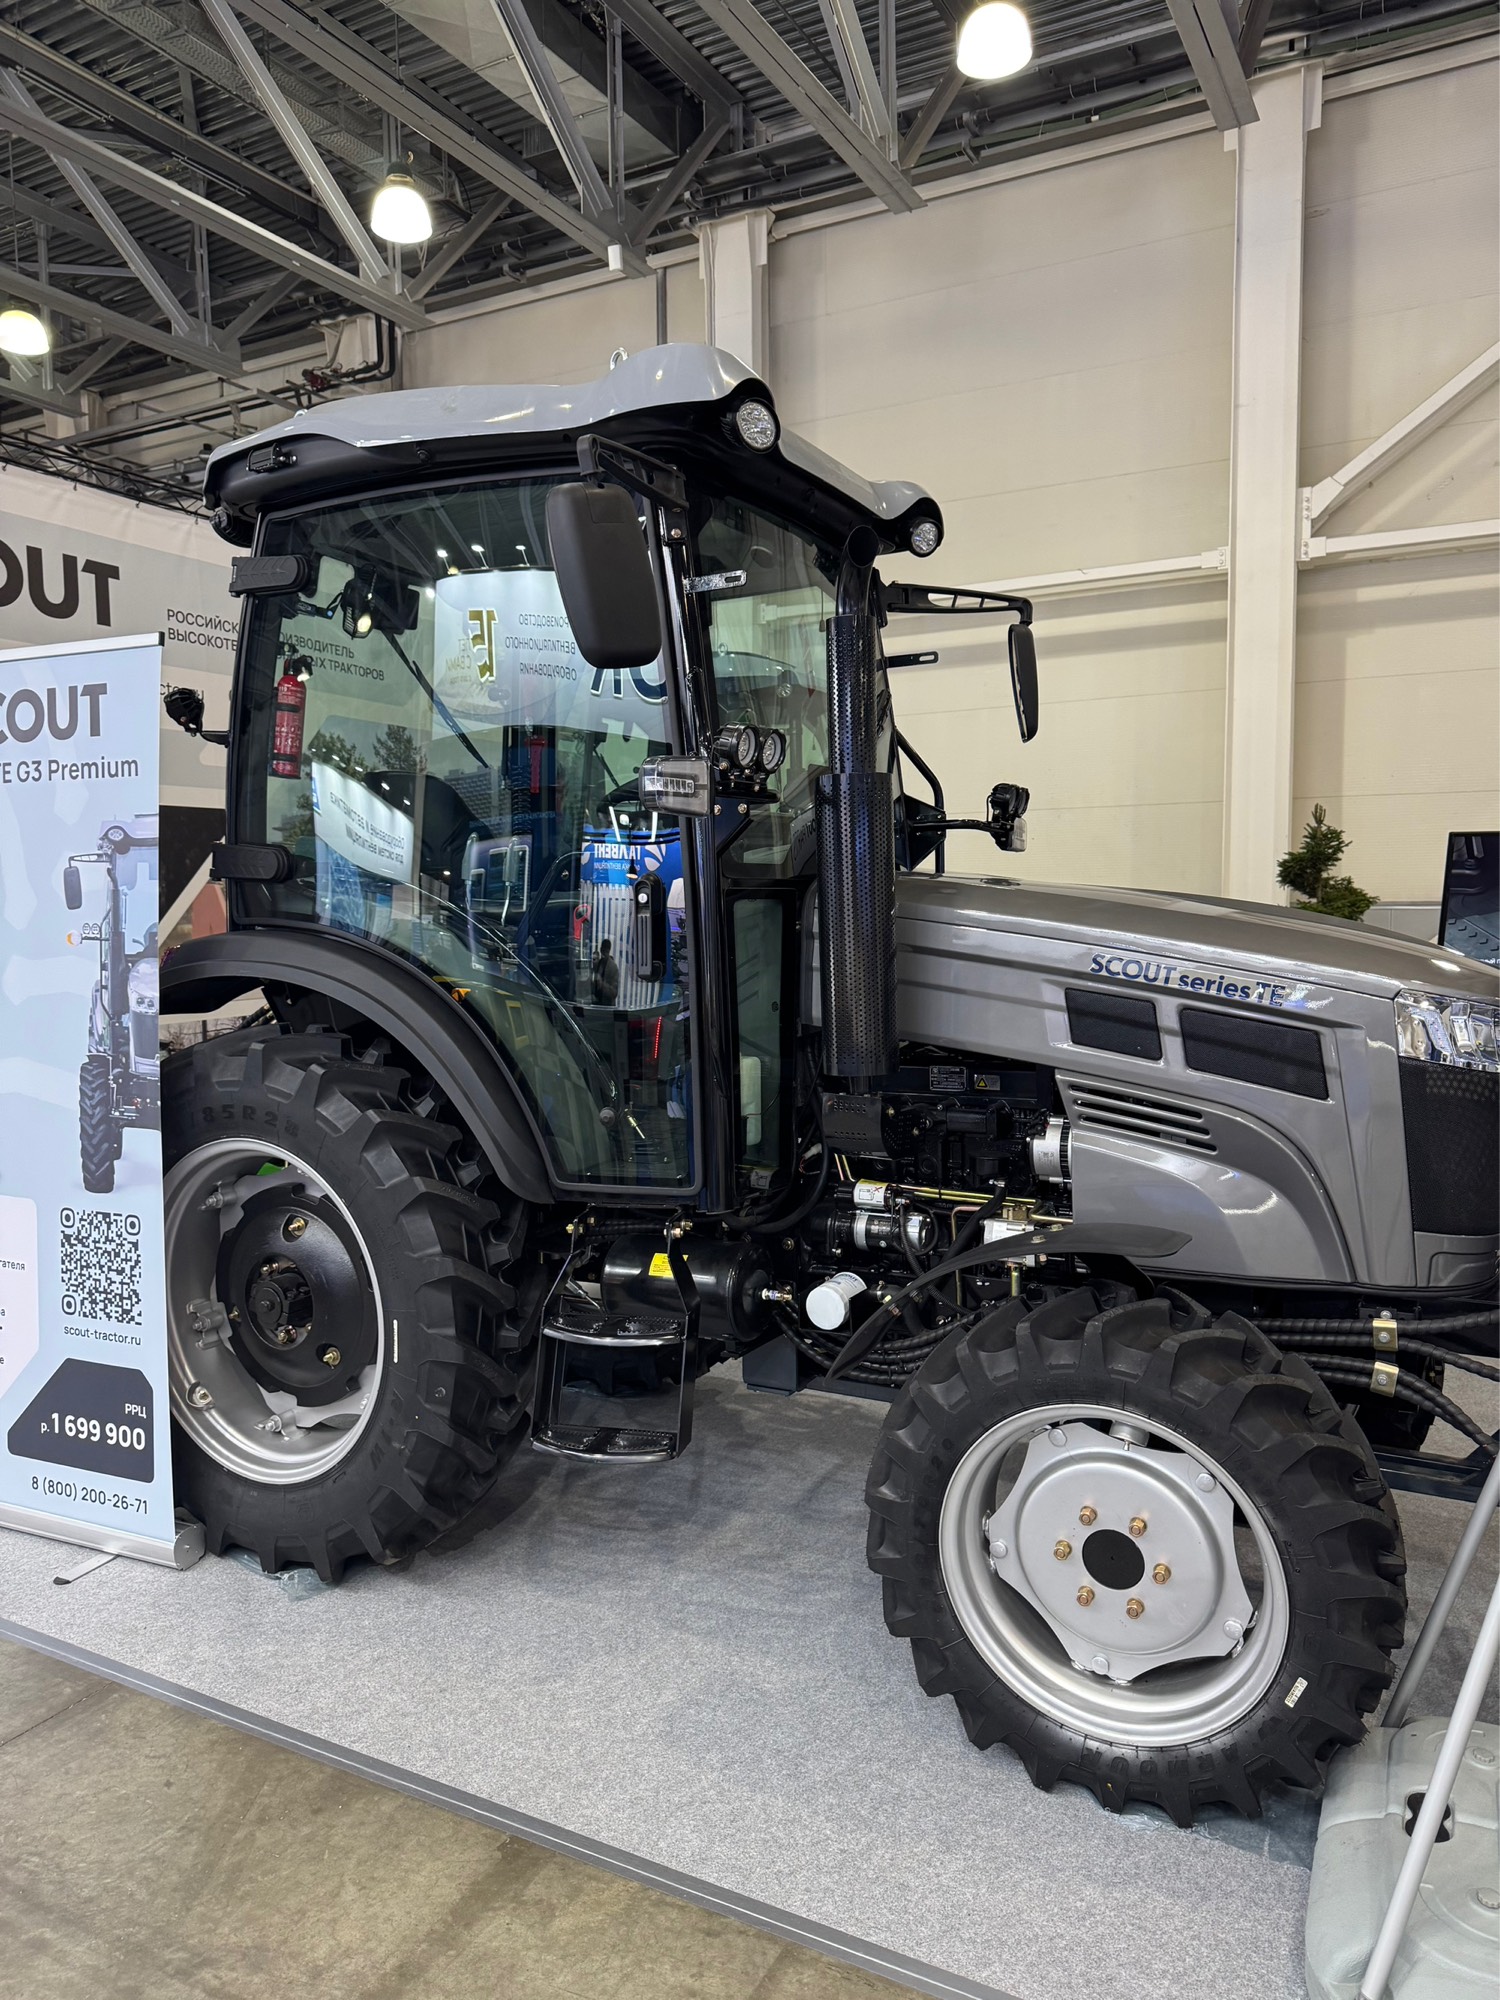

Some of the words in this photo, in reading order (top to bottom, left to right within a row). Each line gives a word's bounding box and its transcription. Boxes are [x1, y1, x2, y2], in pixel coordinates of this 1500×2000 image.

[328, 660, 385, 681] ТРАКТОРОВ
[0, 683, 107, 745] OUT
[16, 760, 42, 783] G3
[48, 756, 139, 781] Premium
[1089, 953, 1177, 986] SCOUT
[1177, 974, 1251, 1000] series
[63, 1324, 142, 1346] scout-tractor.ru
[125, 1403, 147, 1419] РРЦ
[31, 1475, 39, 1490] 8
[42, 1476, 78, 1502] (800)
[81, 1486, 149, 1515] 200-26-71
